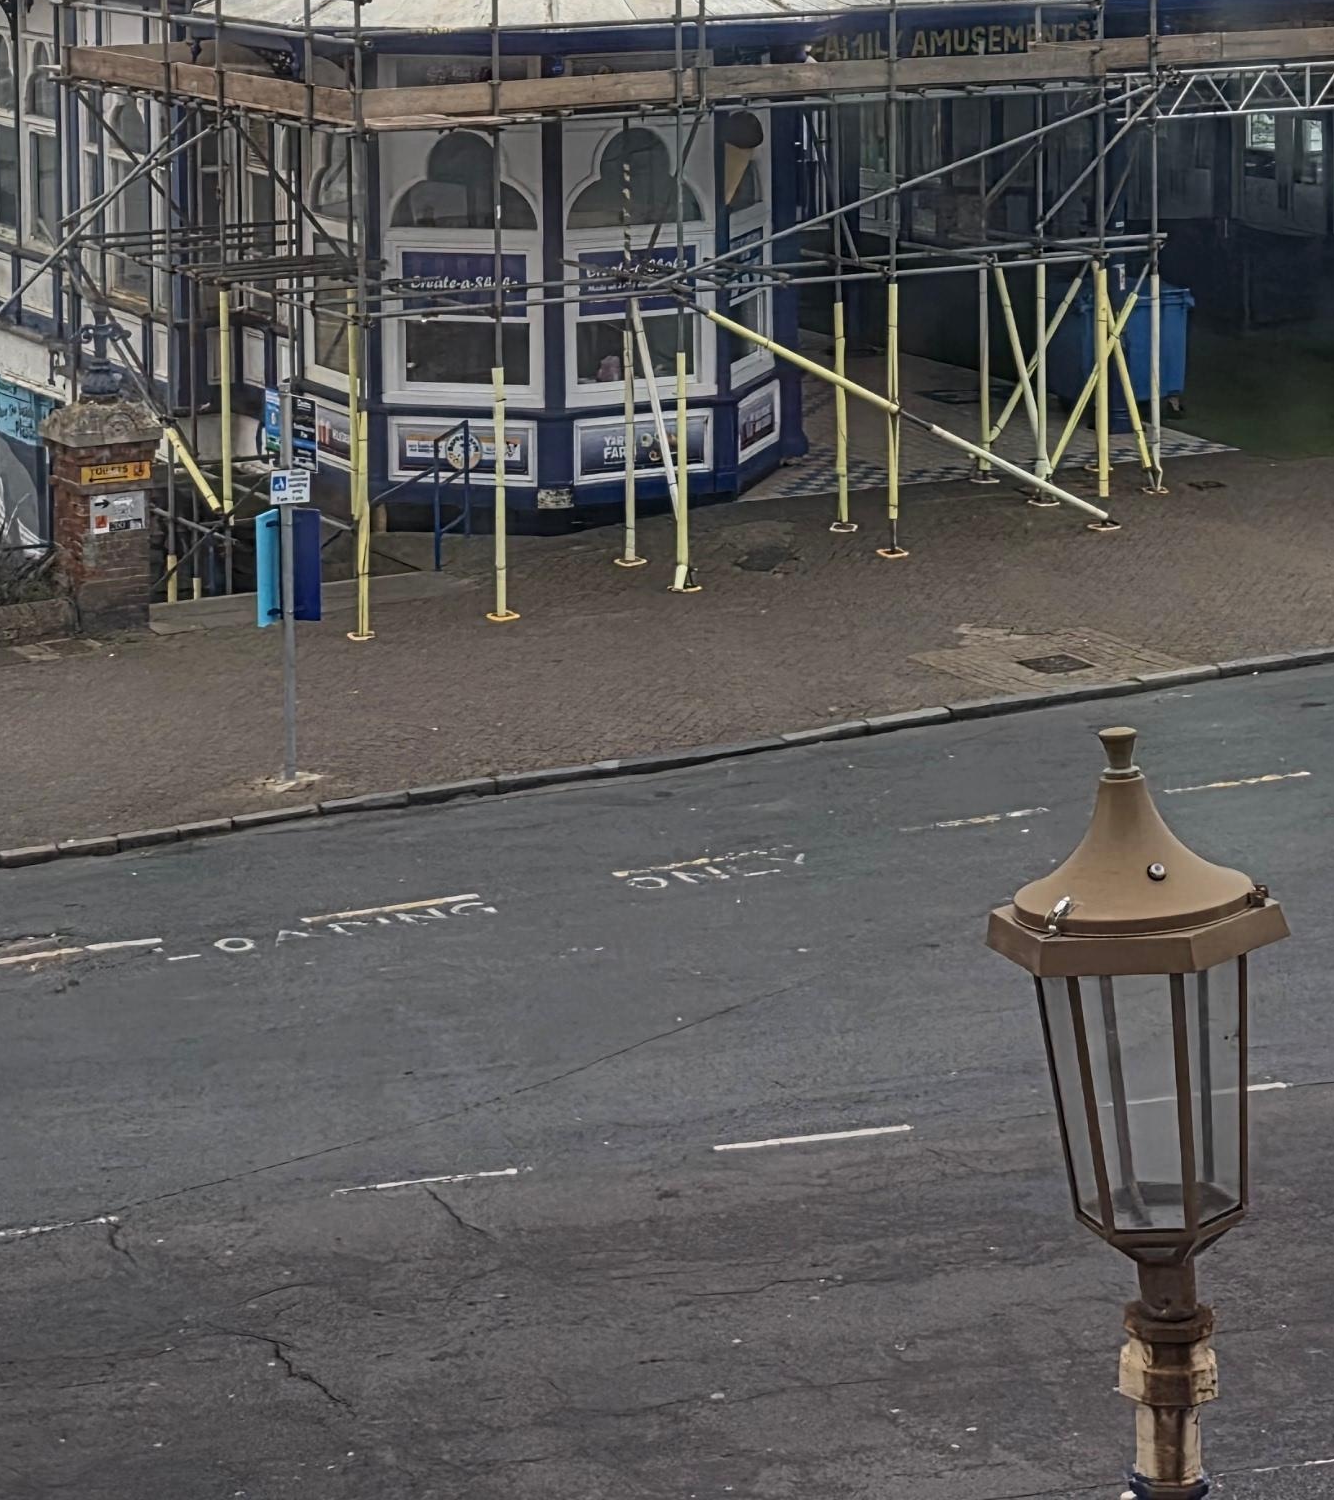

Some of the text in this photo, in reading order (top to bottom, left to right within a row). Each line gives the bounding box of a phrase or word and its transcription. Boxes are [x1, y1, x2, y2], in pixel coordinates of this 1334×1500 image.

[911, 20, 1092, 57] AMUSEMENTS
[411, 275, 518, 290] Create-a-Shke
[604, 447, 636, 458] FAR
